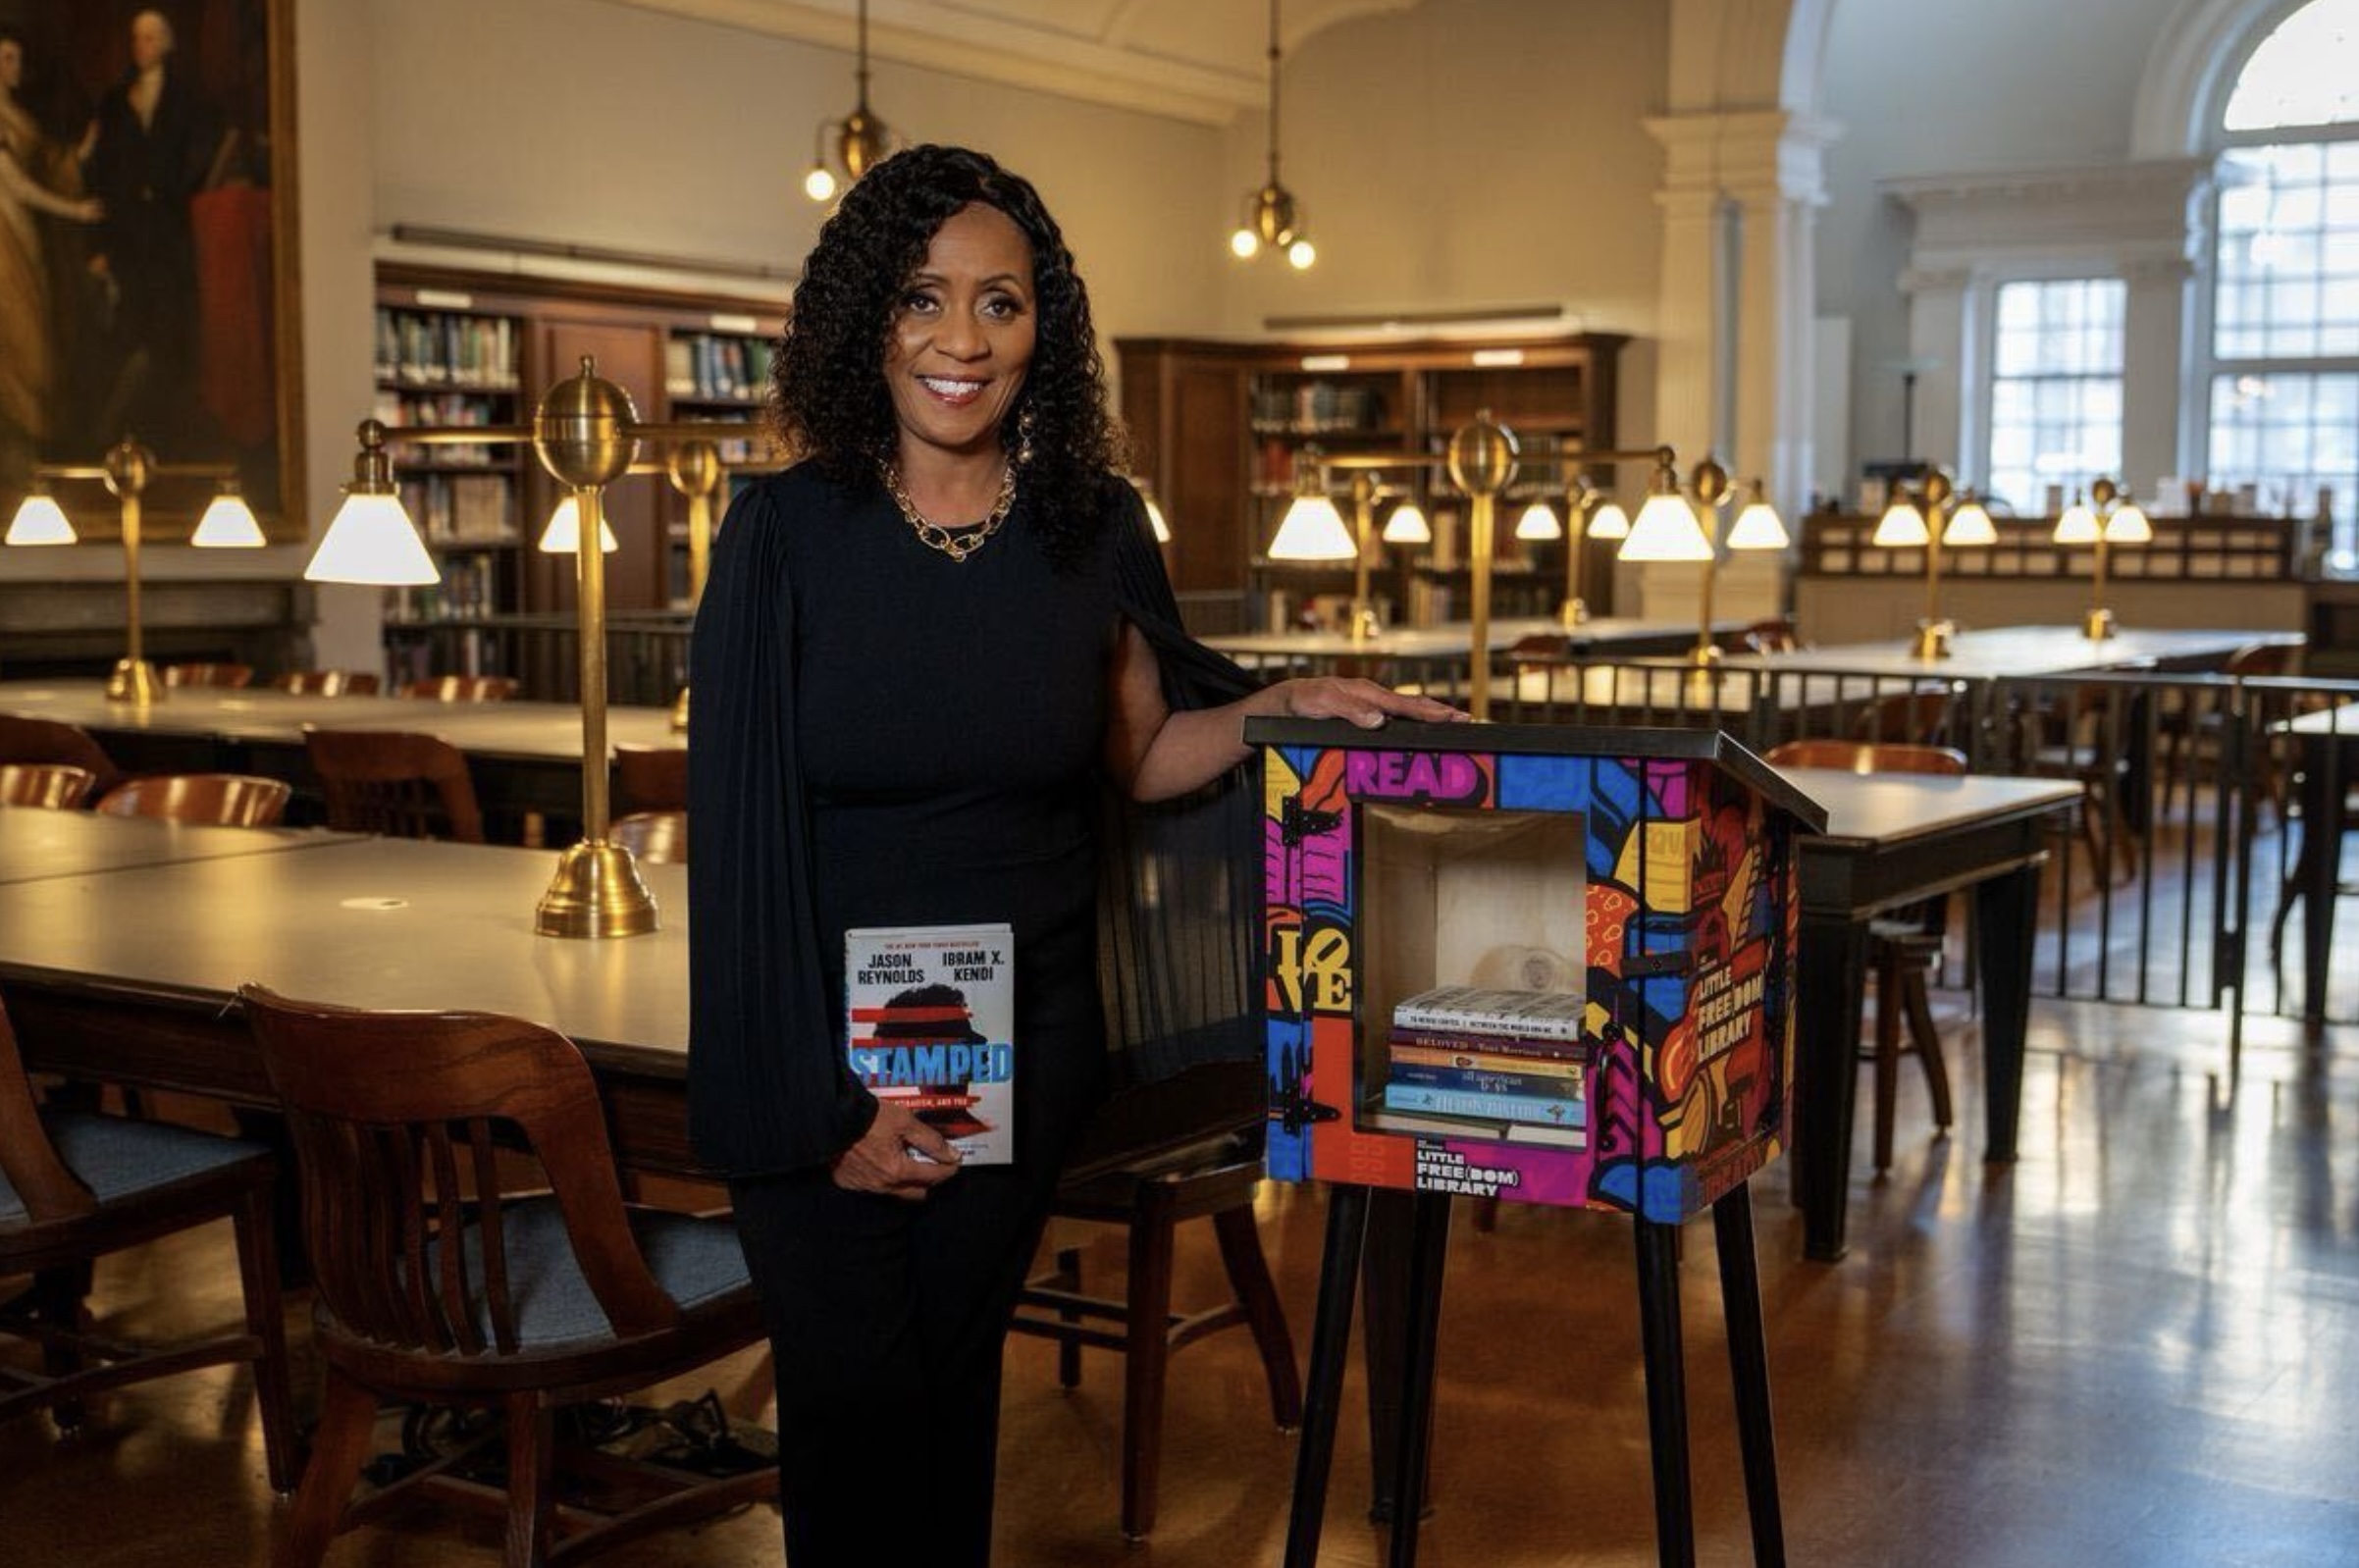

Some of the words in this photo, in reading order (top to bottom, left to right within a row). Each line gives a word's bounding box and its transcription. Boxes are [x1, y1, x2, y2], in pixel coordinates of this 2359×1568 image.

[1346, 751, 1478, 799] READ
[868, 953, 912, 968] JASON
[942, 951, 986, 967] IBRAM
[991, 950, 1005, 965] X.
[858, 969, 925, 984] REYNOLDS
[954, 967, 994, 981] KENDI
[1416, 1037, 1469, 1050] BELOVED
[1699, 1008, 1753, 1064] LIBRARY
[850, 1043, 1012, 1086] STAMPED
[1417, 1150, 1465, 1165] LITTLE
[1417, 1162, 1519, 1186] FREE(DOM)
[1417, 1176, 1498, 1196] LIBRARY
